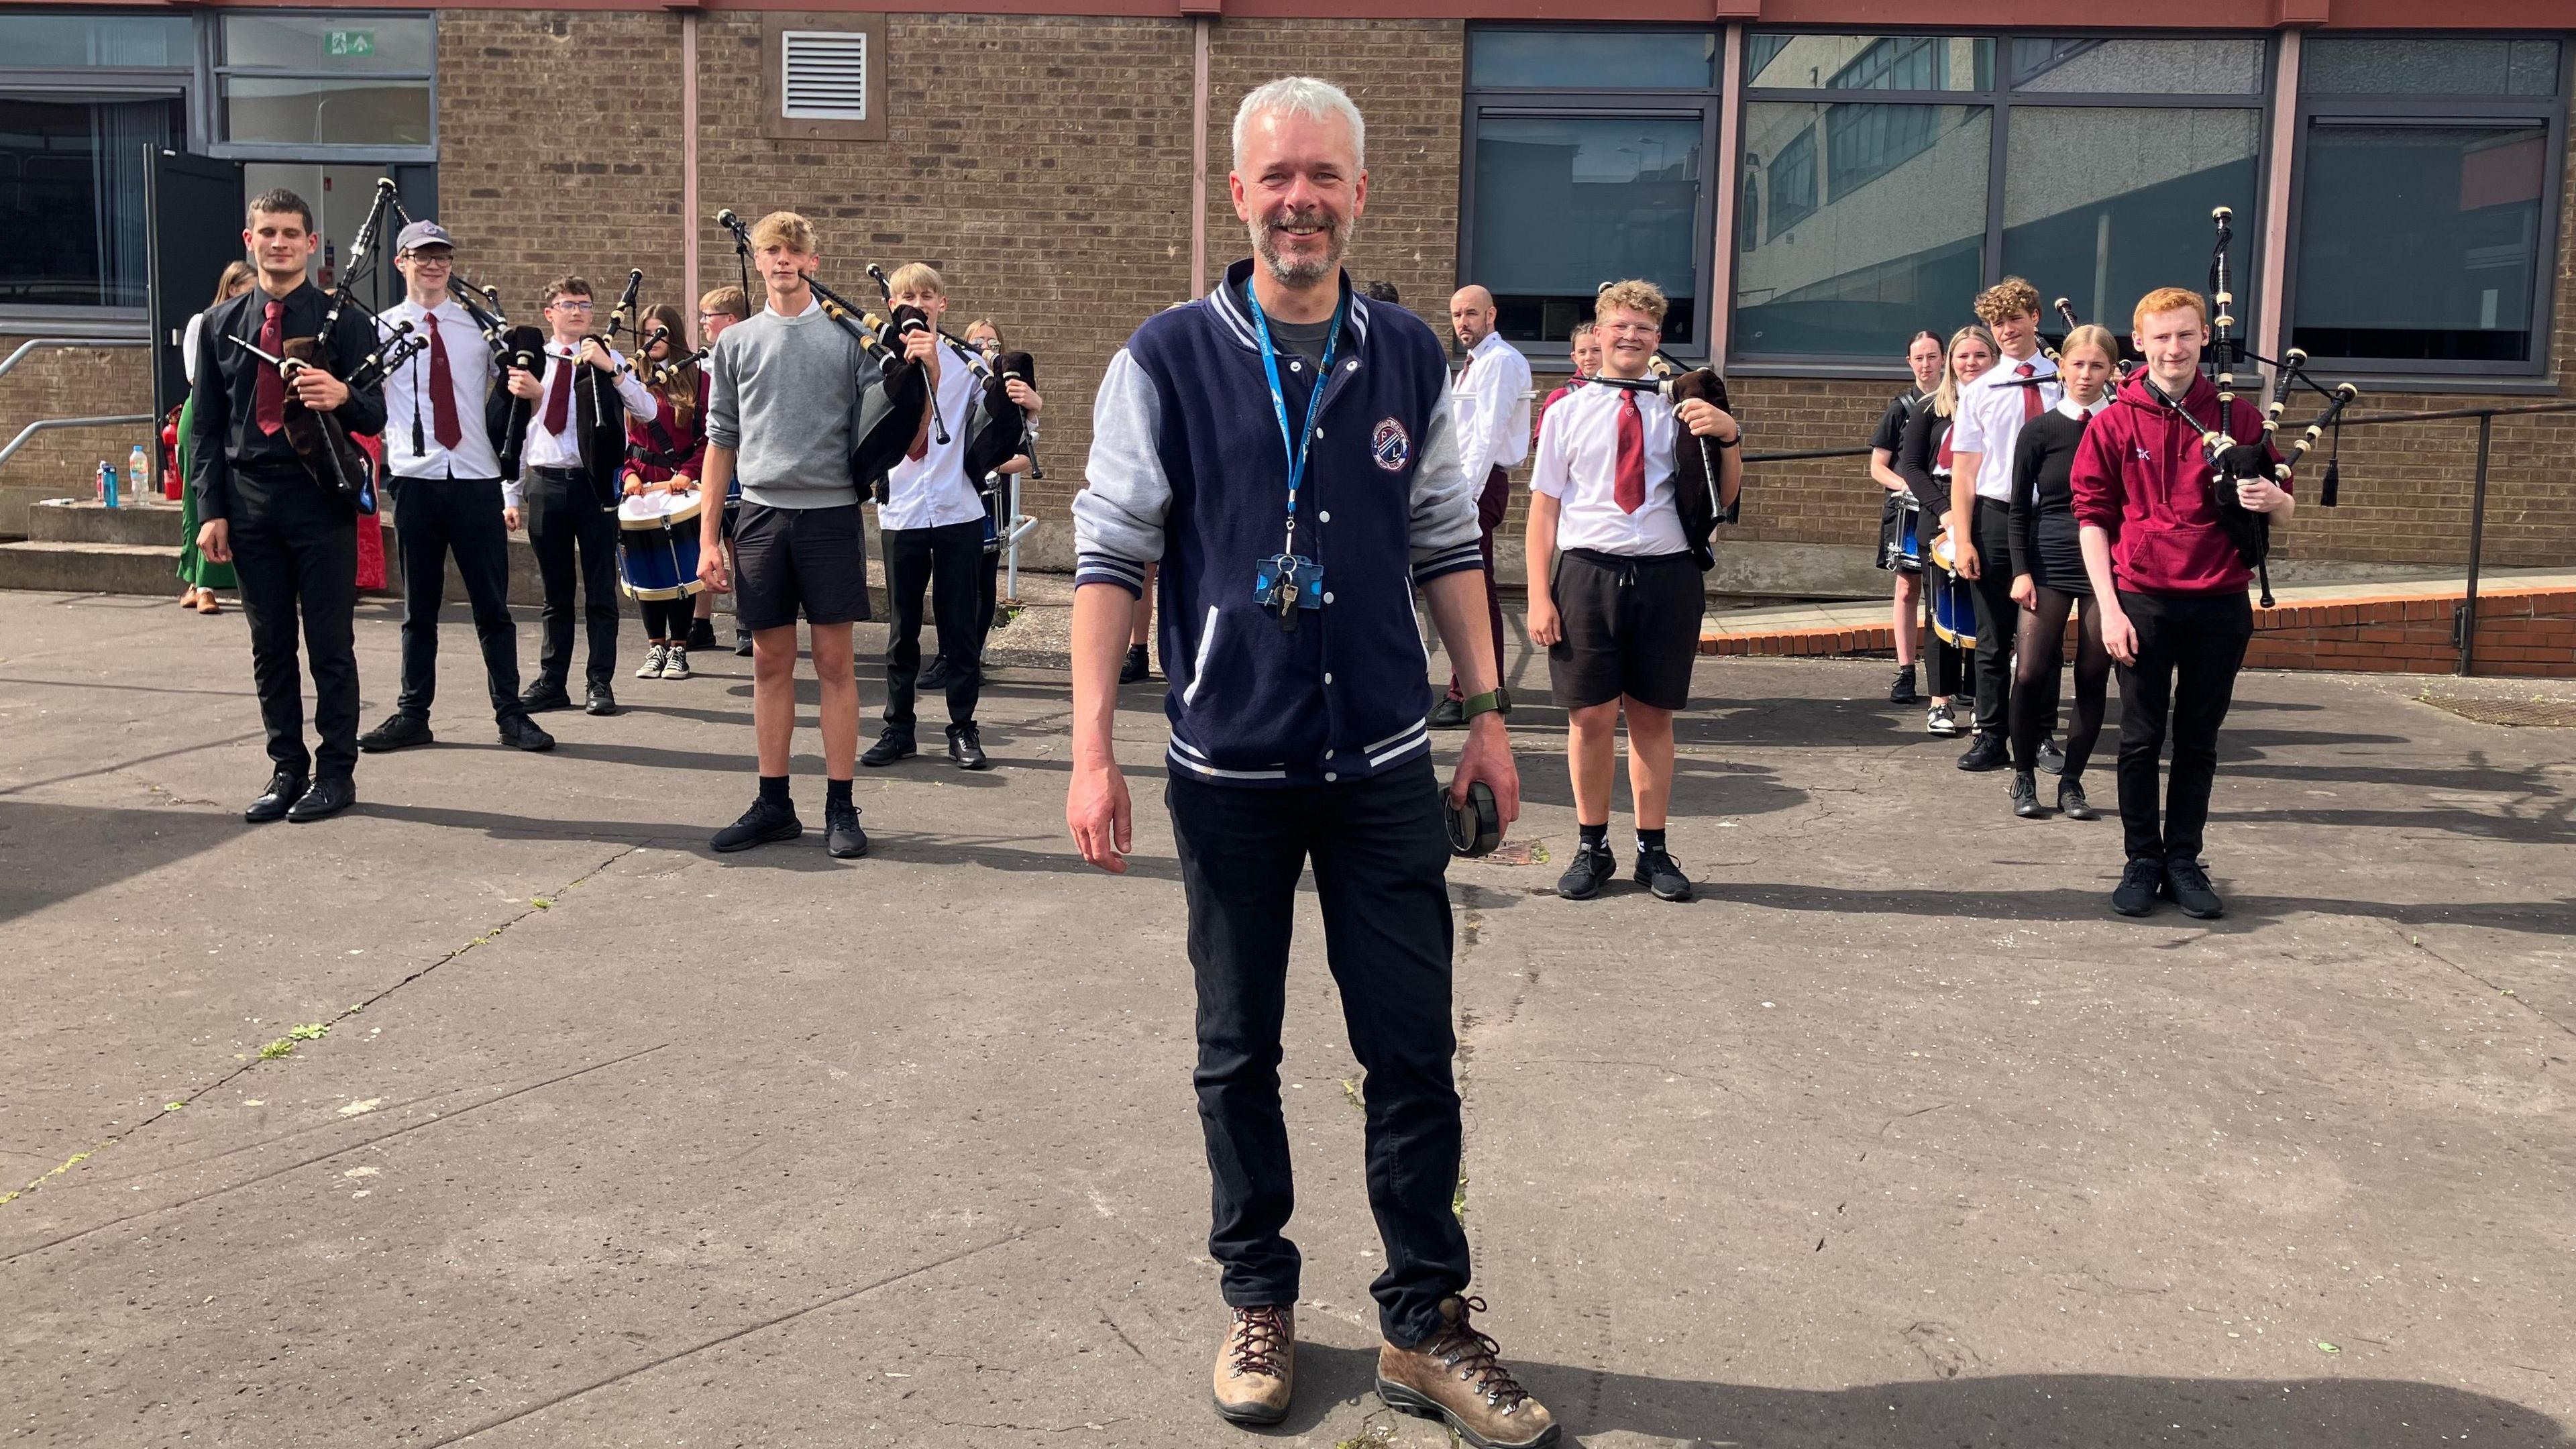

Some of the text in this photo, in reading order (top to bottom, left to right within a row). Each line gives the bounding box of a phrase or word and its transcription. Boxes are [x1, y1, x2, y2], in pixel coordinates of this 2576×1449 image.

[1315, 387, 1324, 407] Council
[1382, 431, 1387, 441] P
[1393, 447, 1399, 457] L
